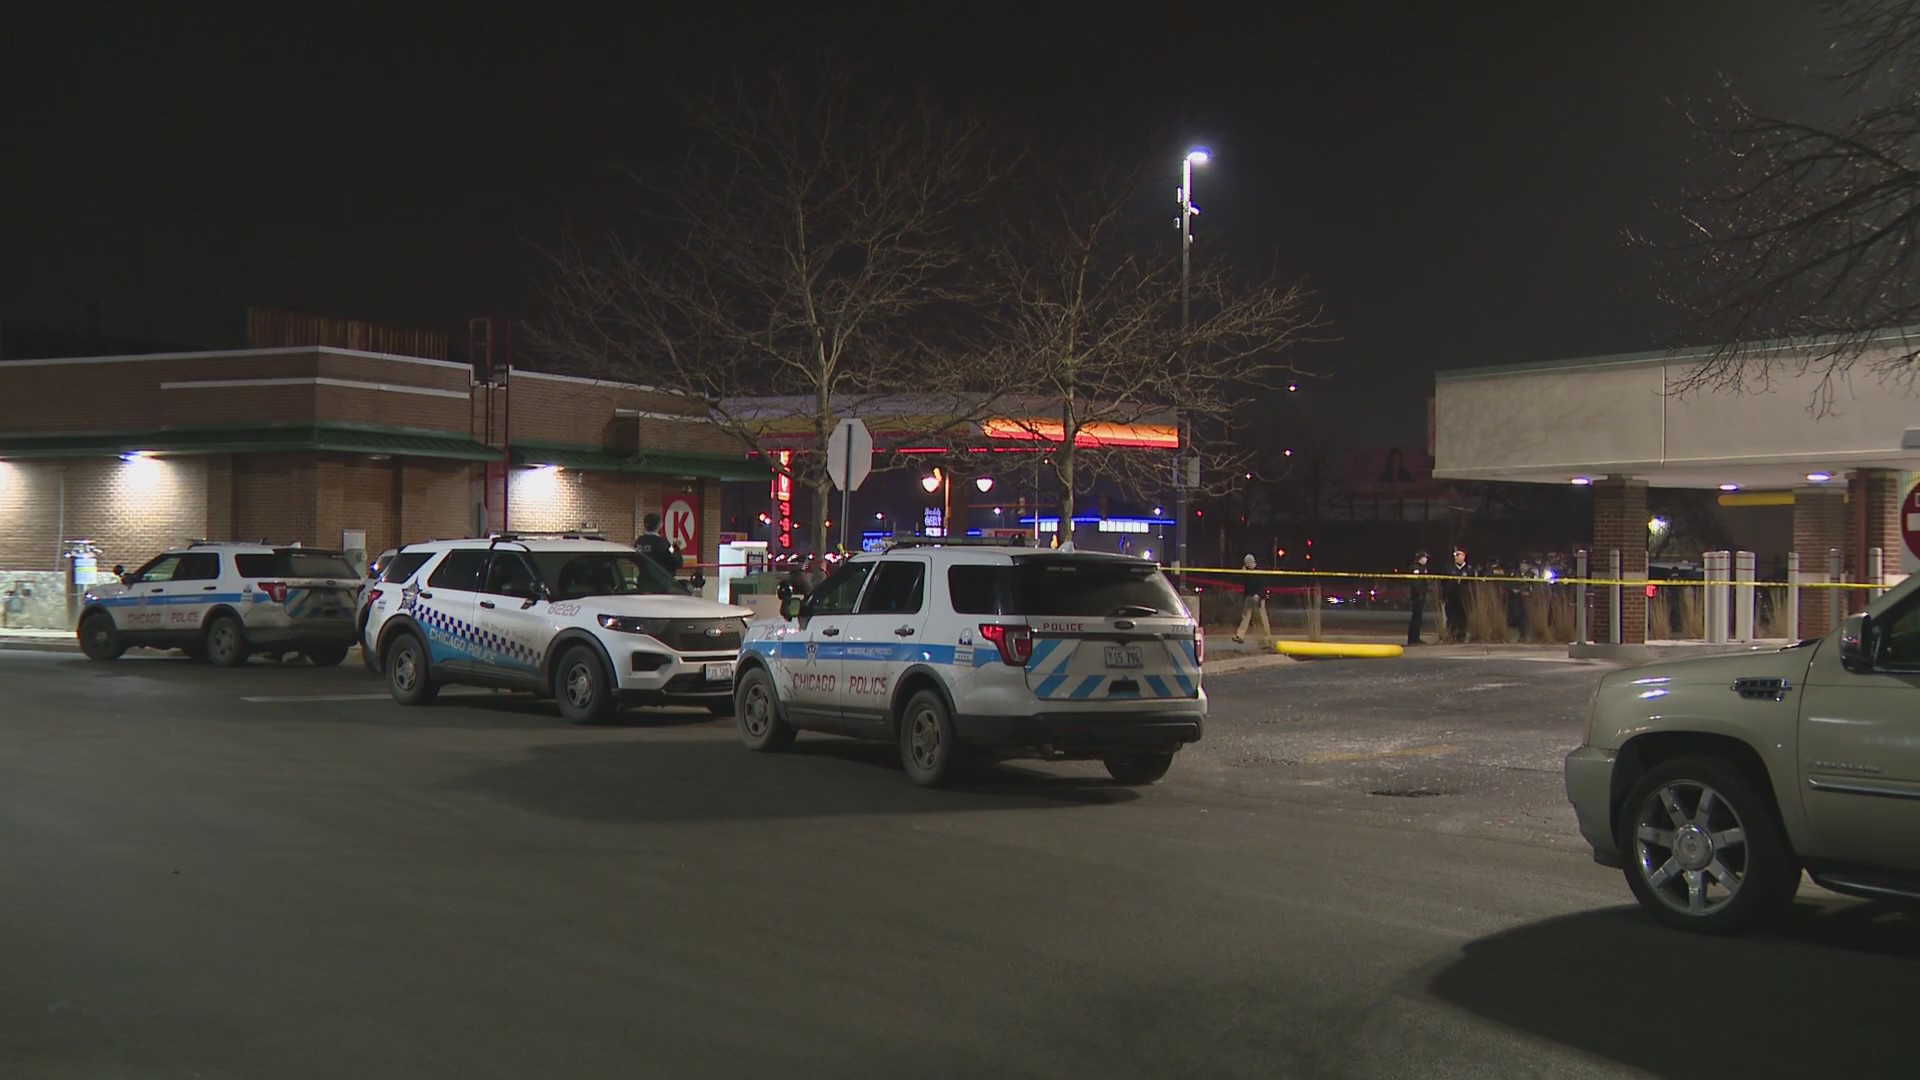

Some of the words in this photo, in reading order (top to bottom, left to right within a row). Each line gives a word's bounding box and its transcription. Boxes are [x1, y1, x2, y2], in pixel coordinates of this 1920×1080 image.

[673, 511, 693, 549] K
[128, 612, 161, 624] CHICAGO
[170, 611, 199, 623] POLICE
[547, 602, 581, 617] 8220
[1042, 622, 1085, 632] POLICE
[429, 626, 467, 653] CHICAGO
[467, 643, 498, 665] POLICE
[793, 673, 836, 692] CHICAGO
[849, 675, 887, 696] POLICE
